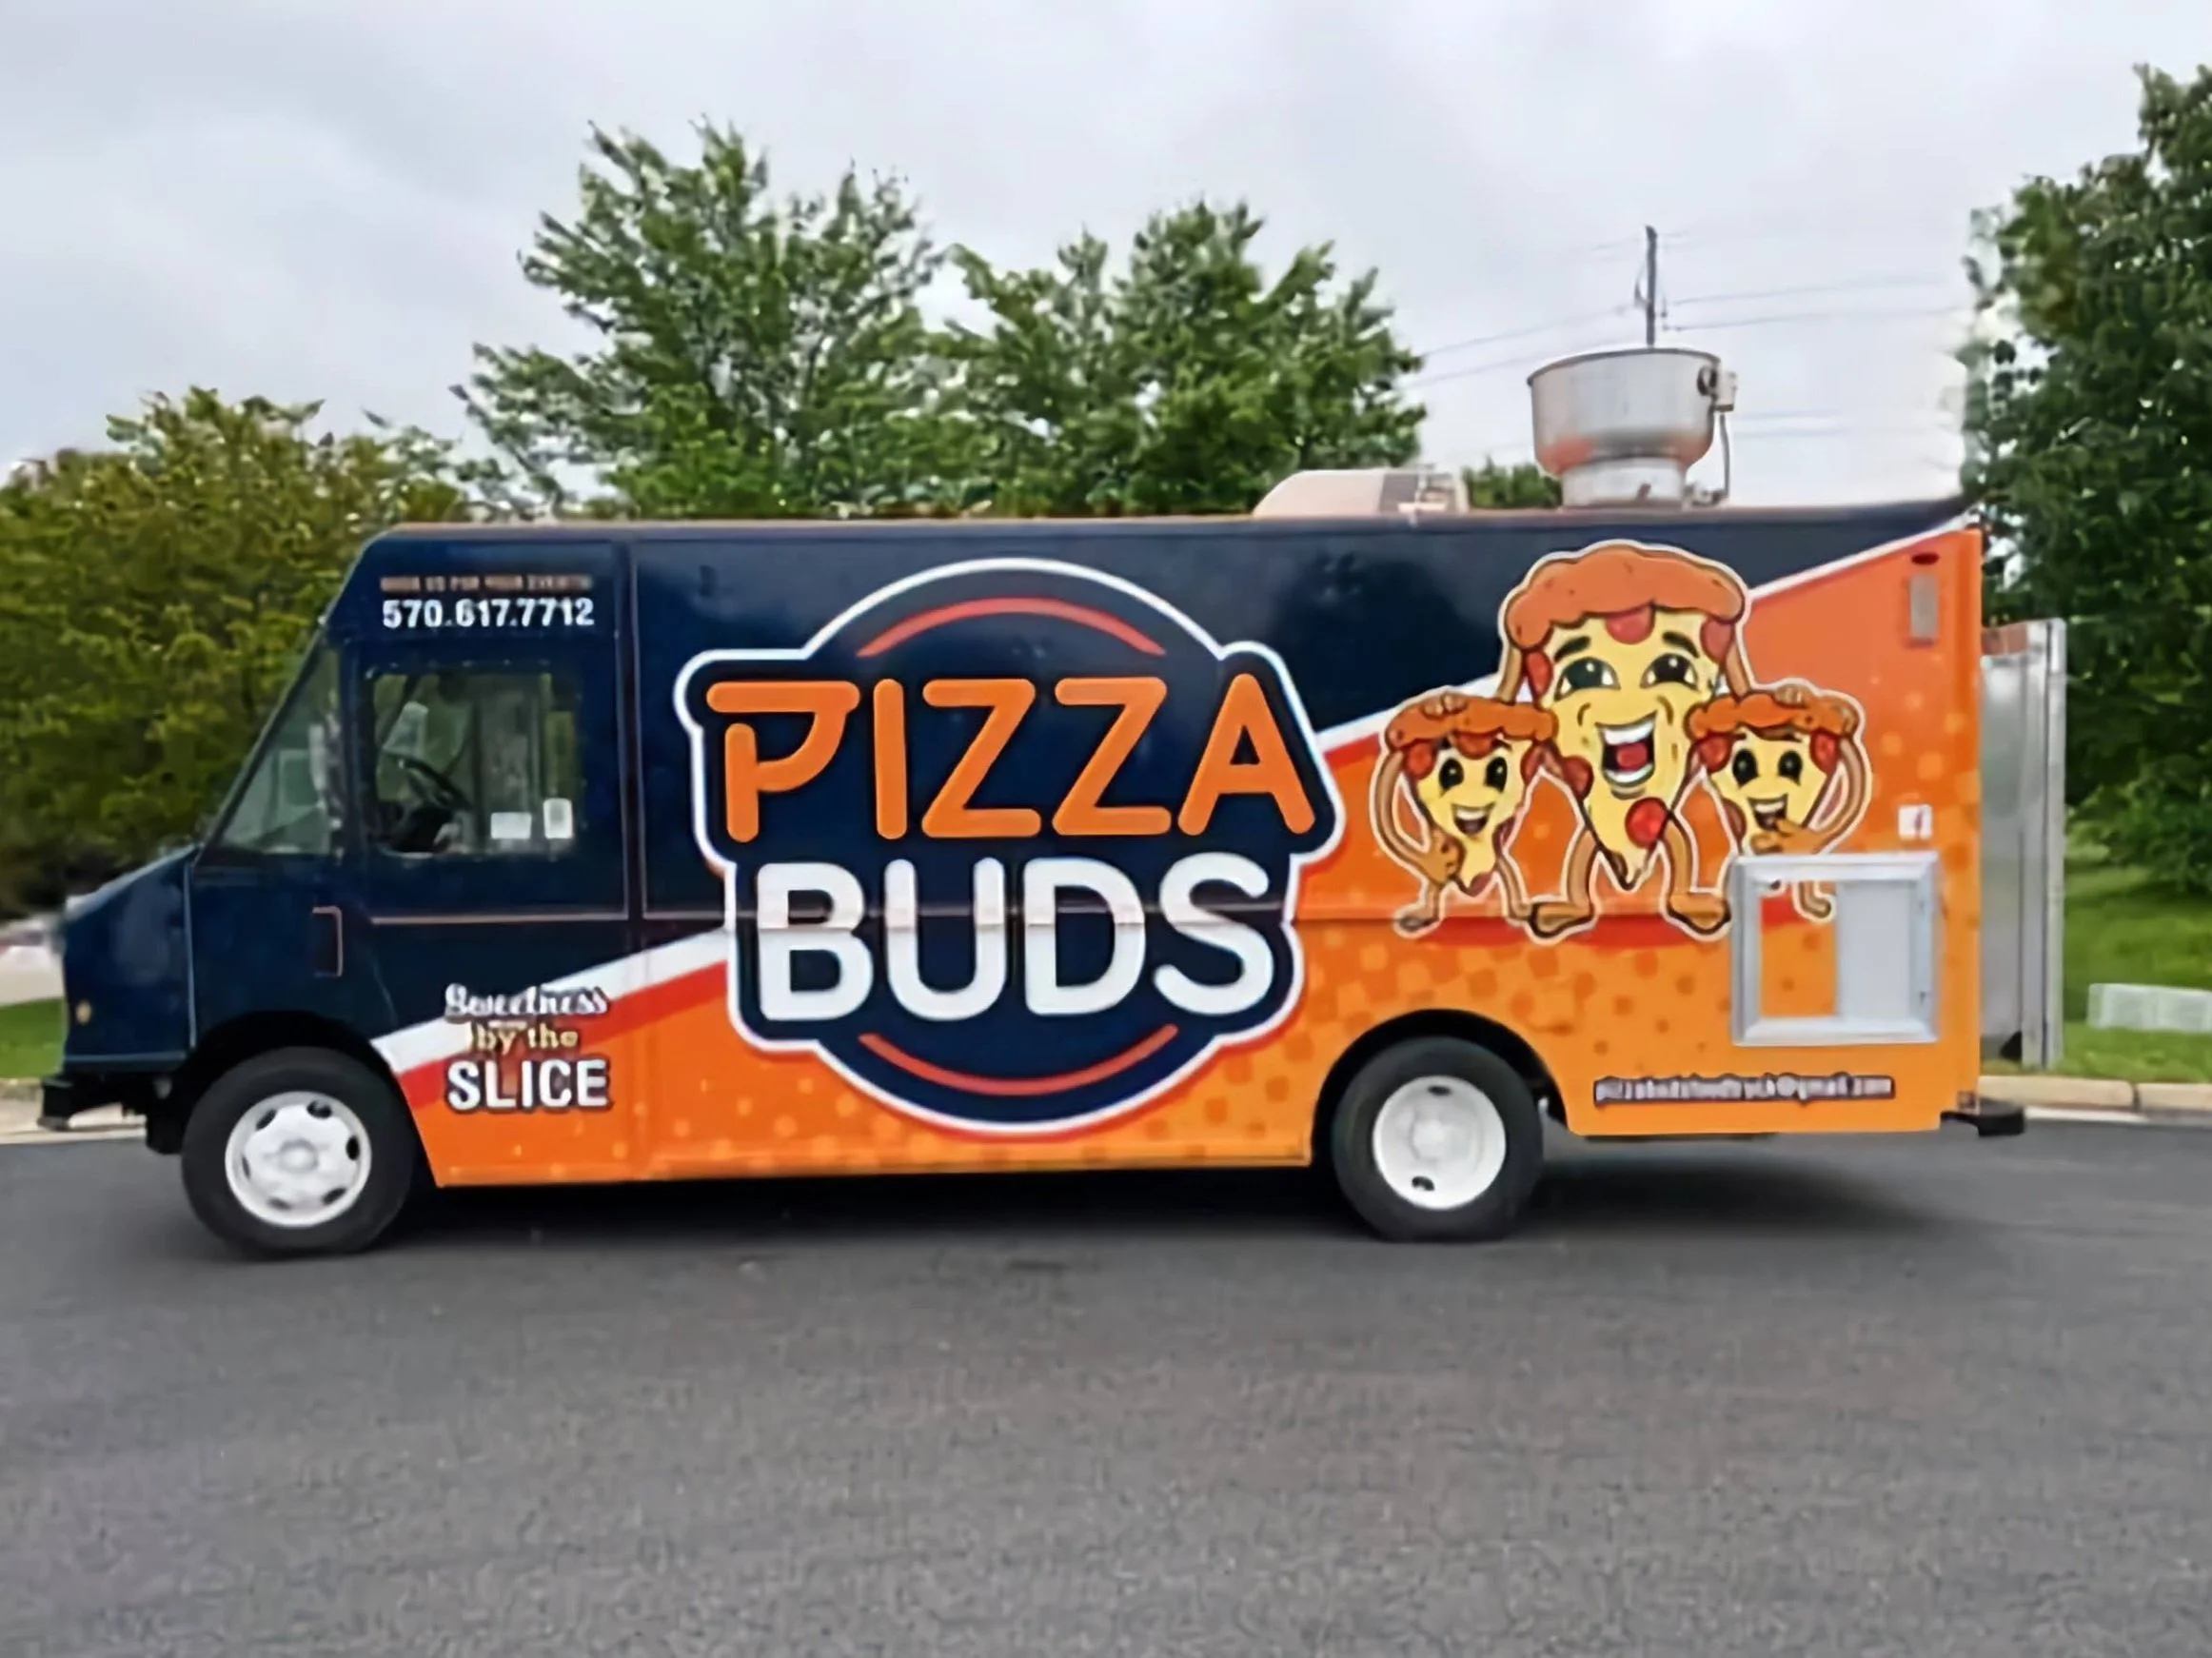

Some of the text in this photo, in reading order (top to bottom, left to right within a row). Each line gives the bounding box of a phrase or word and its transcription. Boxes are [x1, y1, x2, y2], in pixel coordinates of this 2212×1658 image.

[383, 597, 595, 628] 570.617.7712
[706, 673, 1315, 842] PIZZA
[757, 853, 1274, 1021] BUDS
[446, 1058, 609, 1111] SLICE
